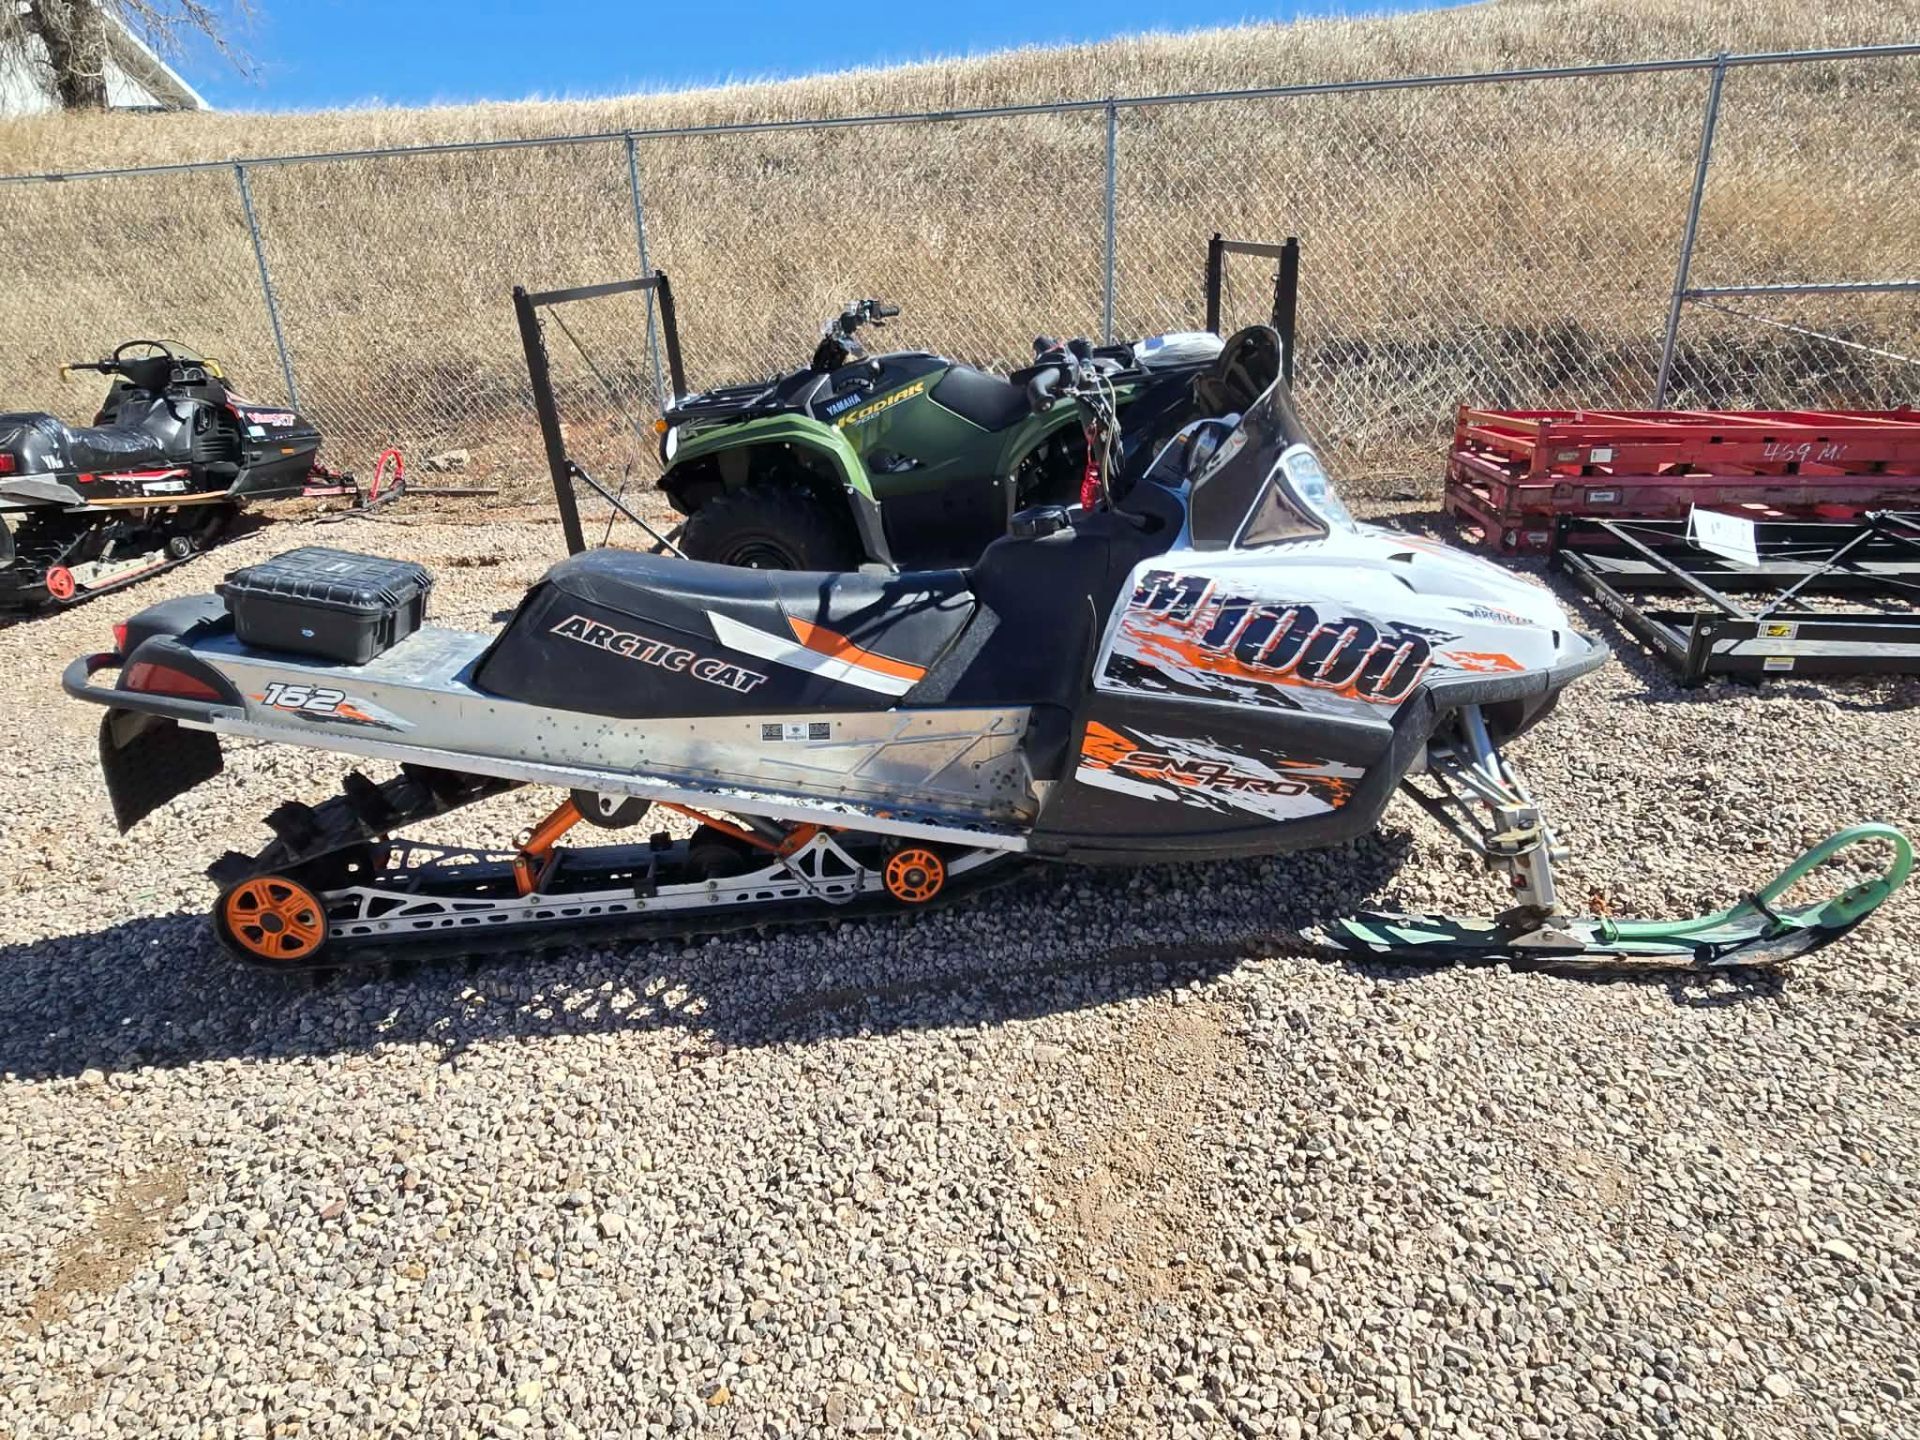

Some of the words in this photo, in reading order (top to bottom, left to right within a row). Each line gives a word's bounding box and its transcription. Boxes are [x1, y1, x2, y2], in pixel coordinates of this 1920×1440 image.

[826, 393, 862, 416] YAMAHA
[550, 614, 697, 672] ARCTIC
[690, 658, 769, 694] CAT
[261, 681, 346, 713] 162
